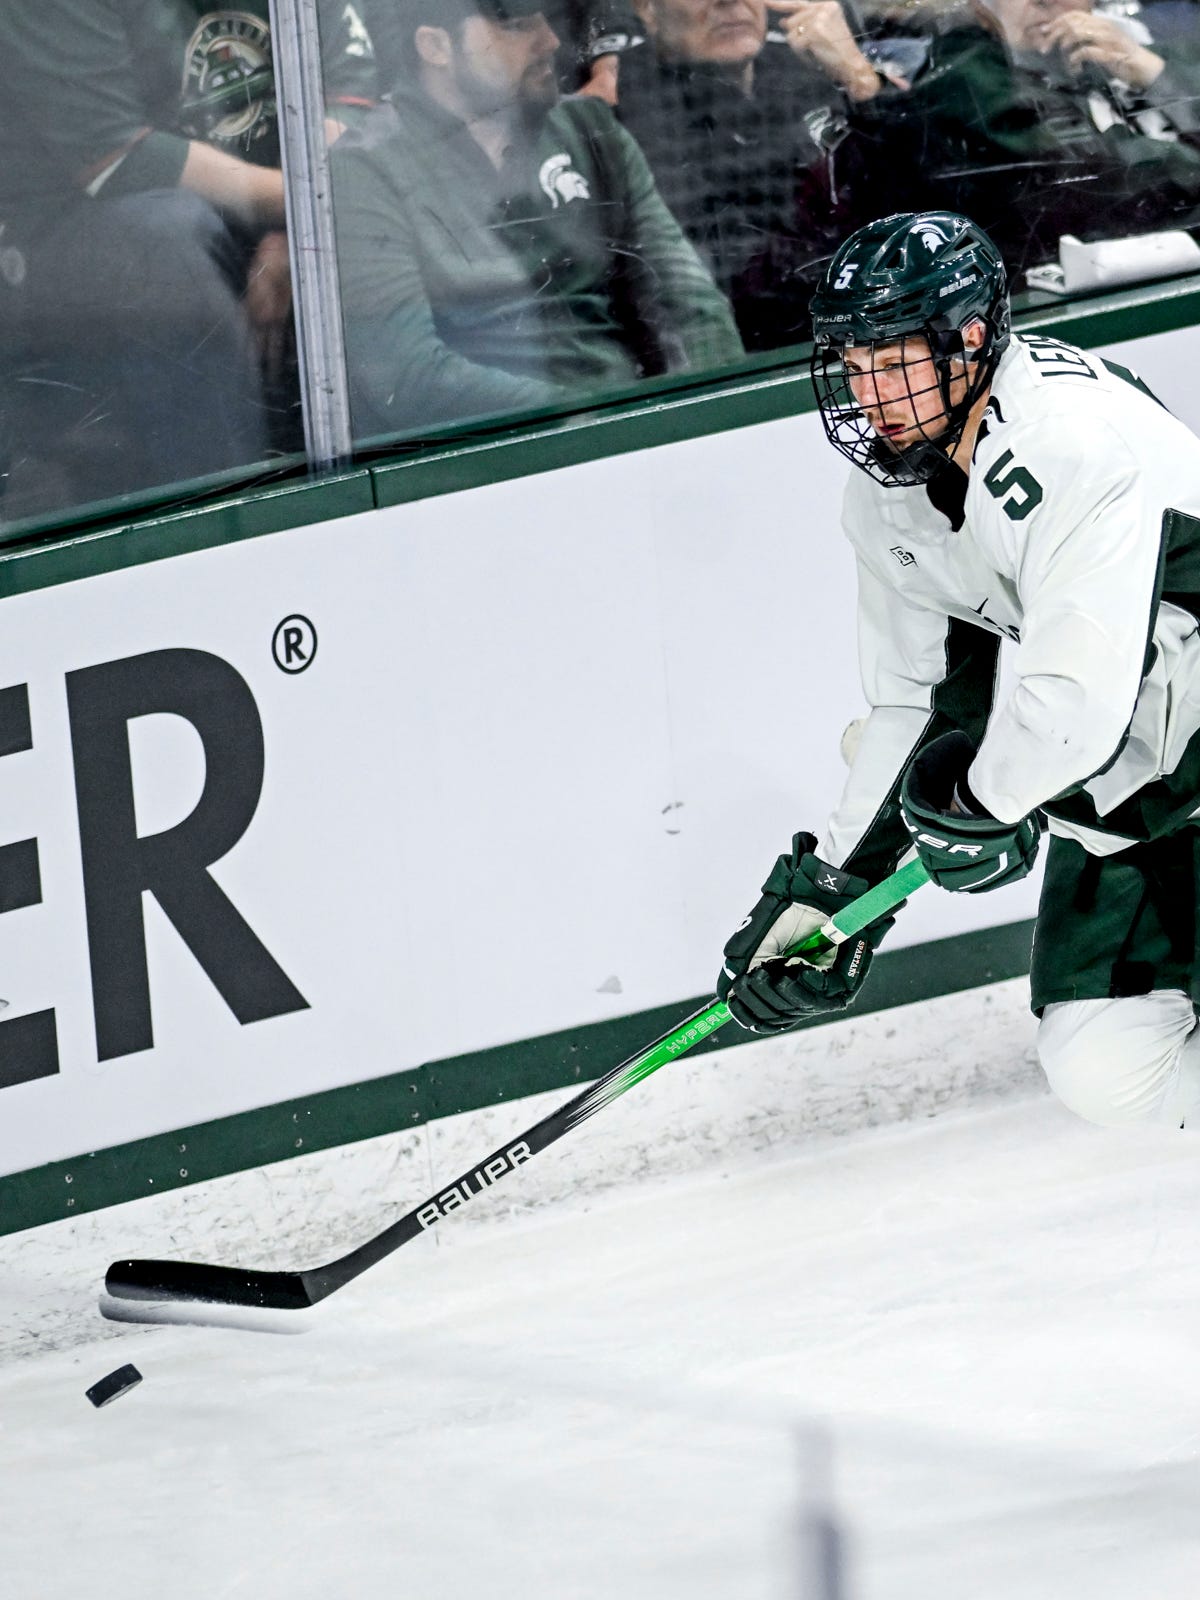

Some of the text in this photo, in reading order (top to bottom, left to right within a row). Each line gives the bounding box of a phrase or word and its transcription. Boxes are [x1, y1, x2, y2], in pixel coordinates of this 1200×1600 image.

[833, 263, 859, 291] 5
[939, 273, 977, 298] BAUER
[983, 448, 1043, 521] 5
[416, 1141, 533, 1230] BAUER
